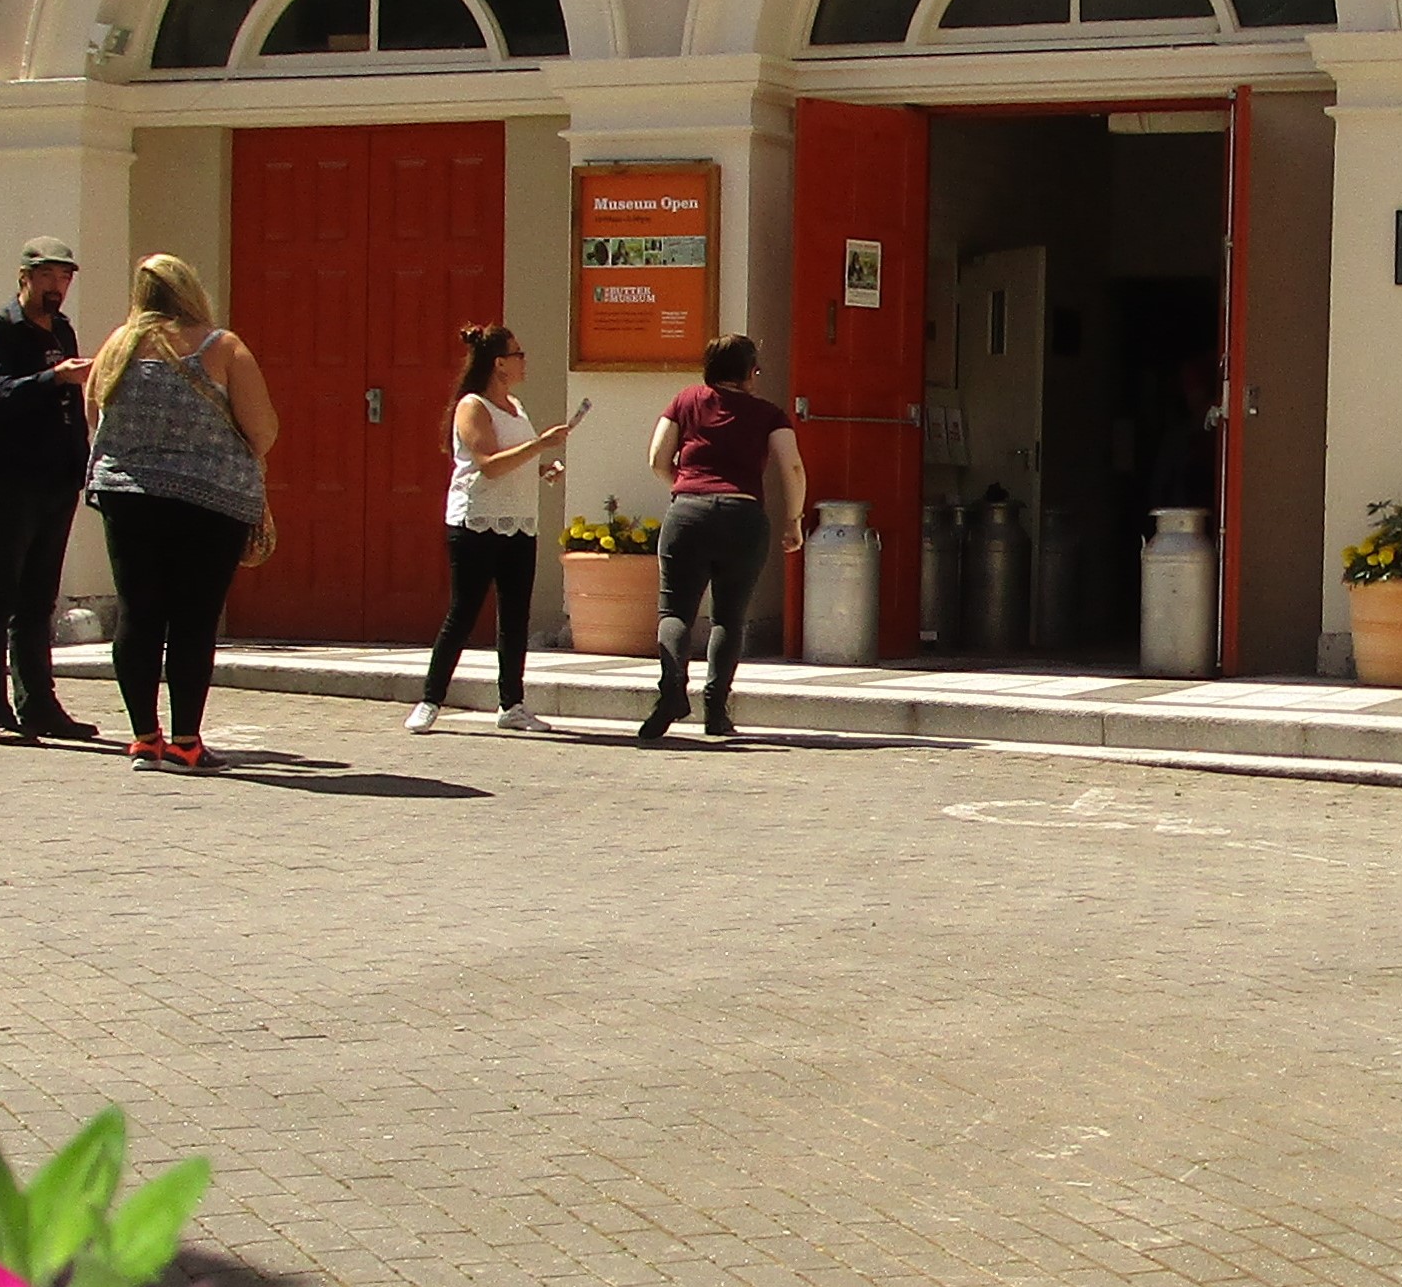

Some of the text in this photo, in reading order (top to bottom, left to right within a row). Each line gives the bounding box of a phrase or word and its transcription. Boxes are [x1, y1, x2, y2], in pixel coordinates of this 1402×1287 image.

[593, 195, 699, 213] Museum Open
[608, 294, 656, 303] MUSEUM
